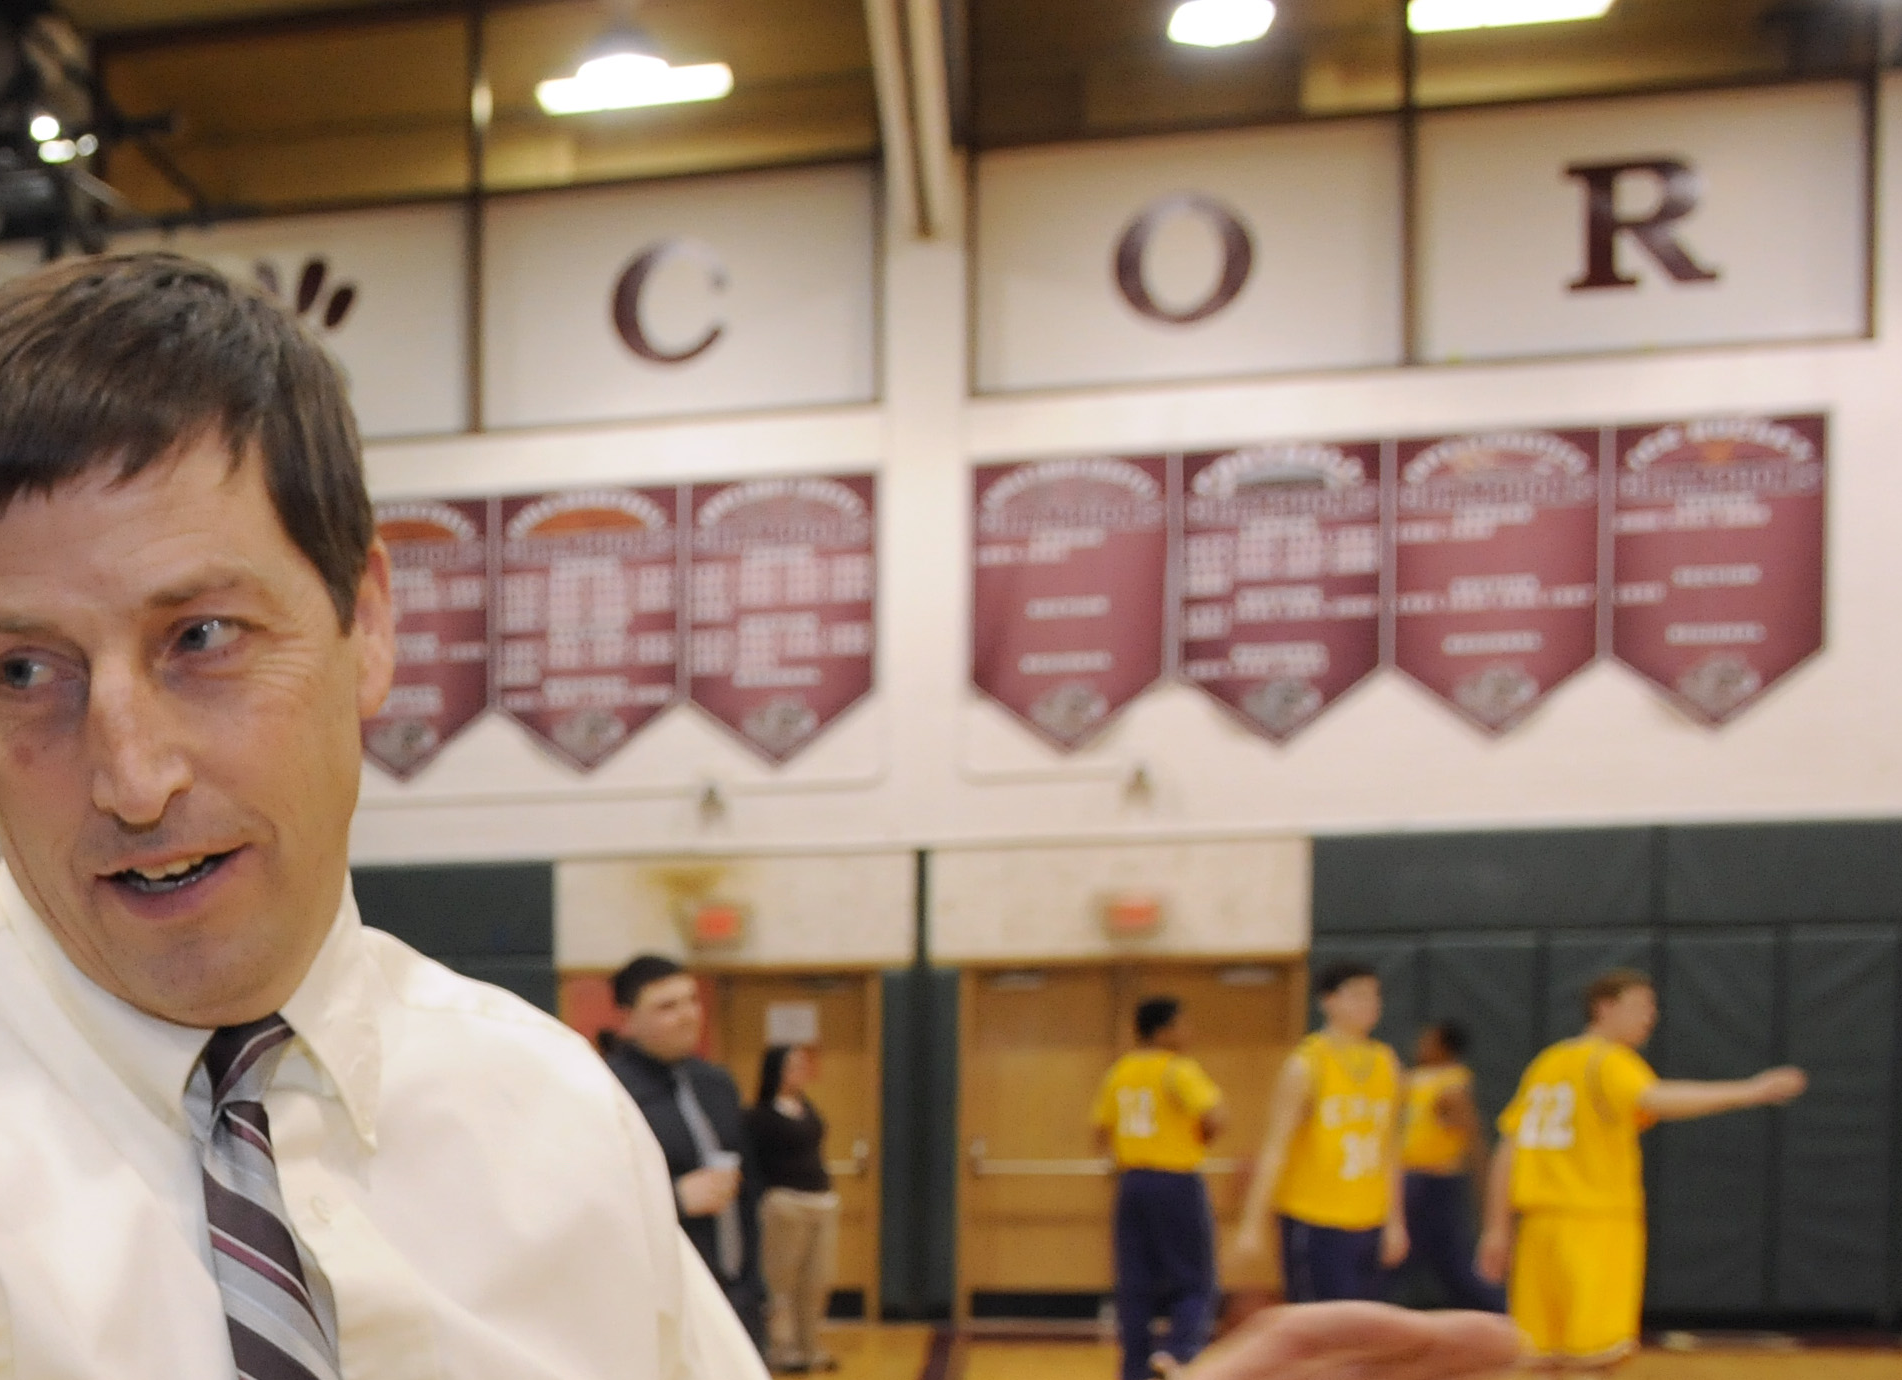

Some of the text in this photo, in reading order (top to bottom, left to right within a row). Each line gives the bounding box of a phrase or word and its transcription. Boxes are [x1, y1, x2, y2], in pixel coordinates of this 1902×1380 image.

[610, 152, 1720, 367] C O R
[1518, 1081, 1576, 1150] 22
